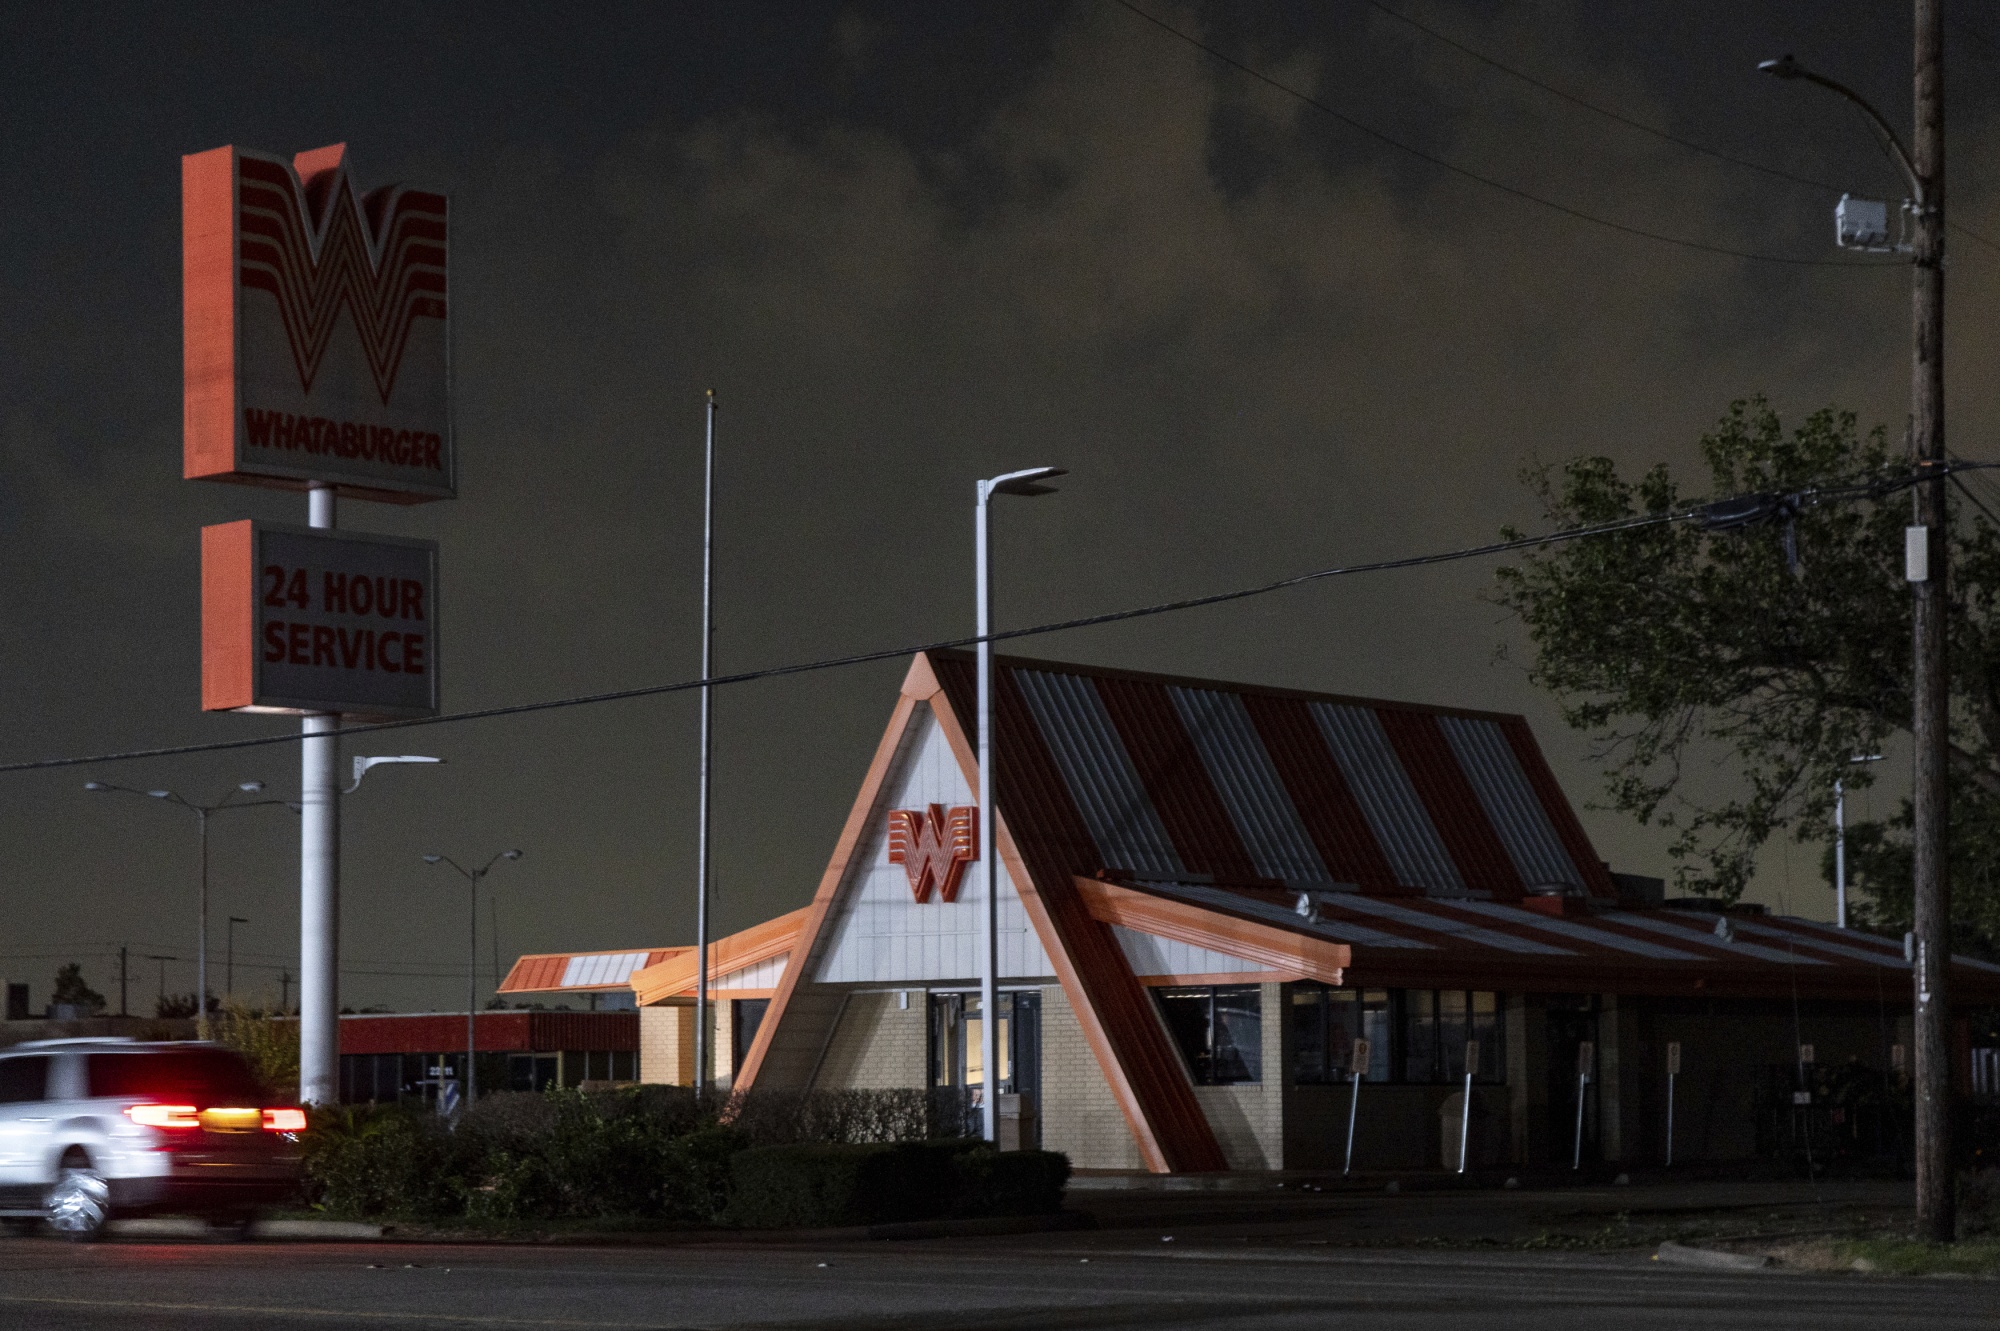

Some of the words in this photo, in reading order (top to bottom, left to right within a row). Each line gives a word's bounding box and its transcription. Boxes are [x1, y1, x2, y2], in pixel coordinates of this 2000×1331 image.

[245, 408, 441, 471] WHATABURGER
[264, 565, 308, 609] 24
[324, 571, 424, 620] HOUR
[264, 620, 424, 674] SERVICE
[888, 804, 979, 904] W
